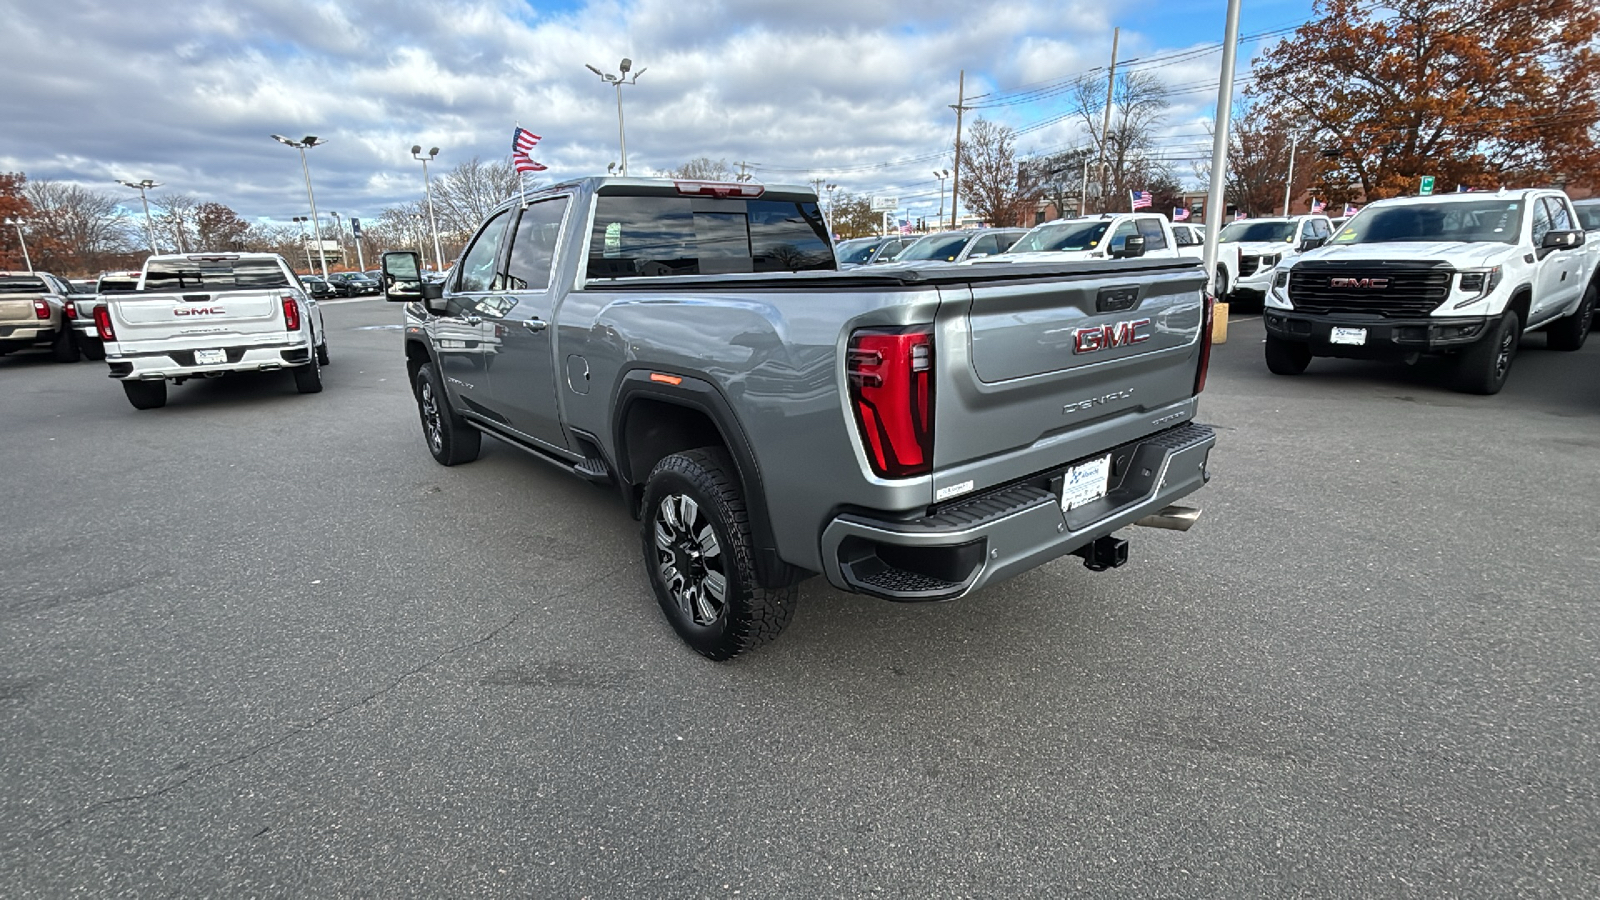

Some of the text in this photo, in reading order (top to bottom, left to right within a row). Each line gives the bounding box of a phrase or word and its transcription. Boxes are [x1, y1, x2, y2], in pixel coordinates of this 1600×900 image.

[1331, 277, 1389, 289] GMC
[173, 306, 226, 316] GMC
[1071, 318, 1150, 355] GMC
